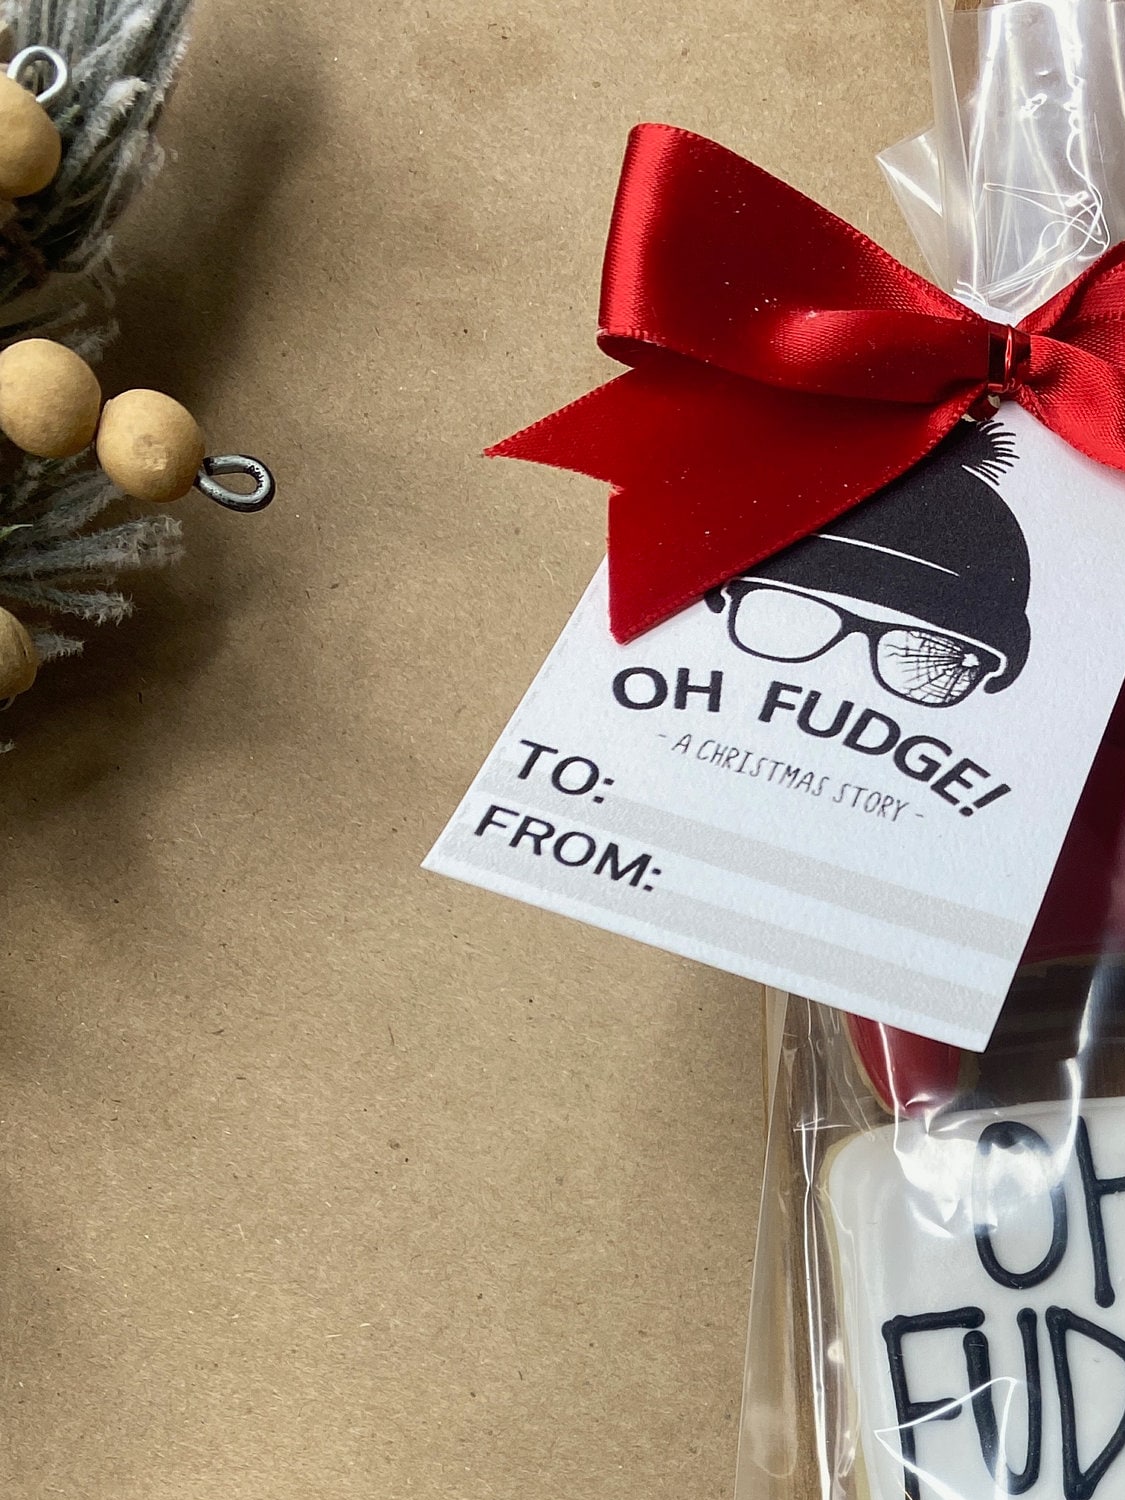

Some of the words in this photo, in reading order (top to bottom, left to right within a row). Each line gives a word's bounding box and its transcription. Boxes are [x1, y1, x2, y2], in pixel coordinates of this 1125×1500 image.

[516, 739, 616, 804] TO:
[612, 666, 724, 713] OH
[758, 680, 1012, 818] FUDGE!
[696, 739, 830, 798] CHRISTMAS
[832, 782, 911, 824] STORY
[473, 804, 663, 893] FROM:
